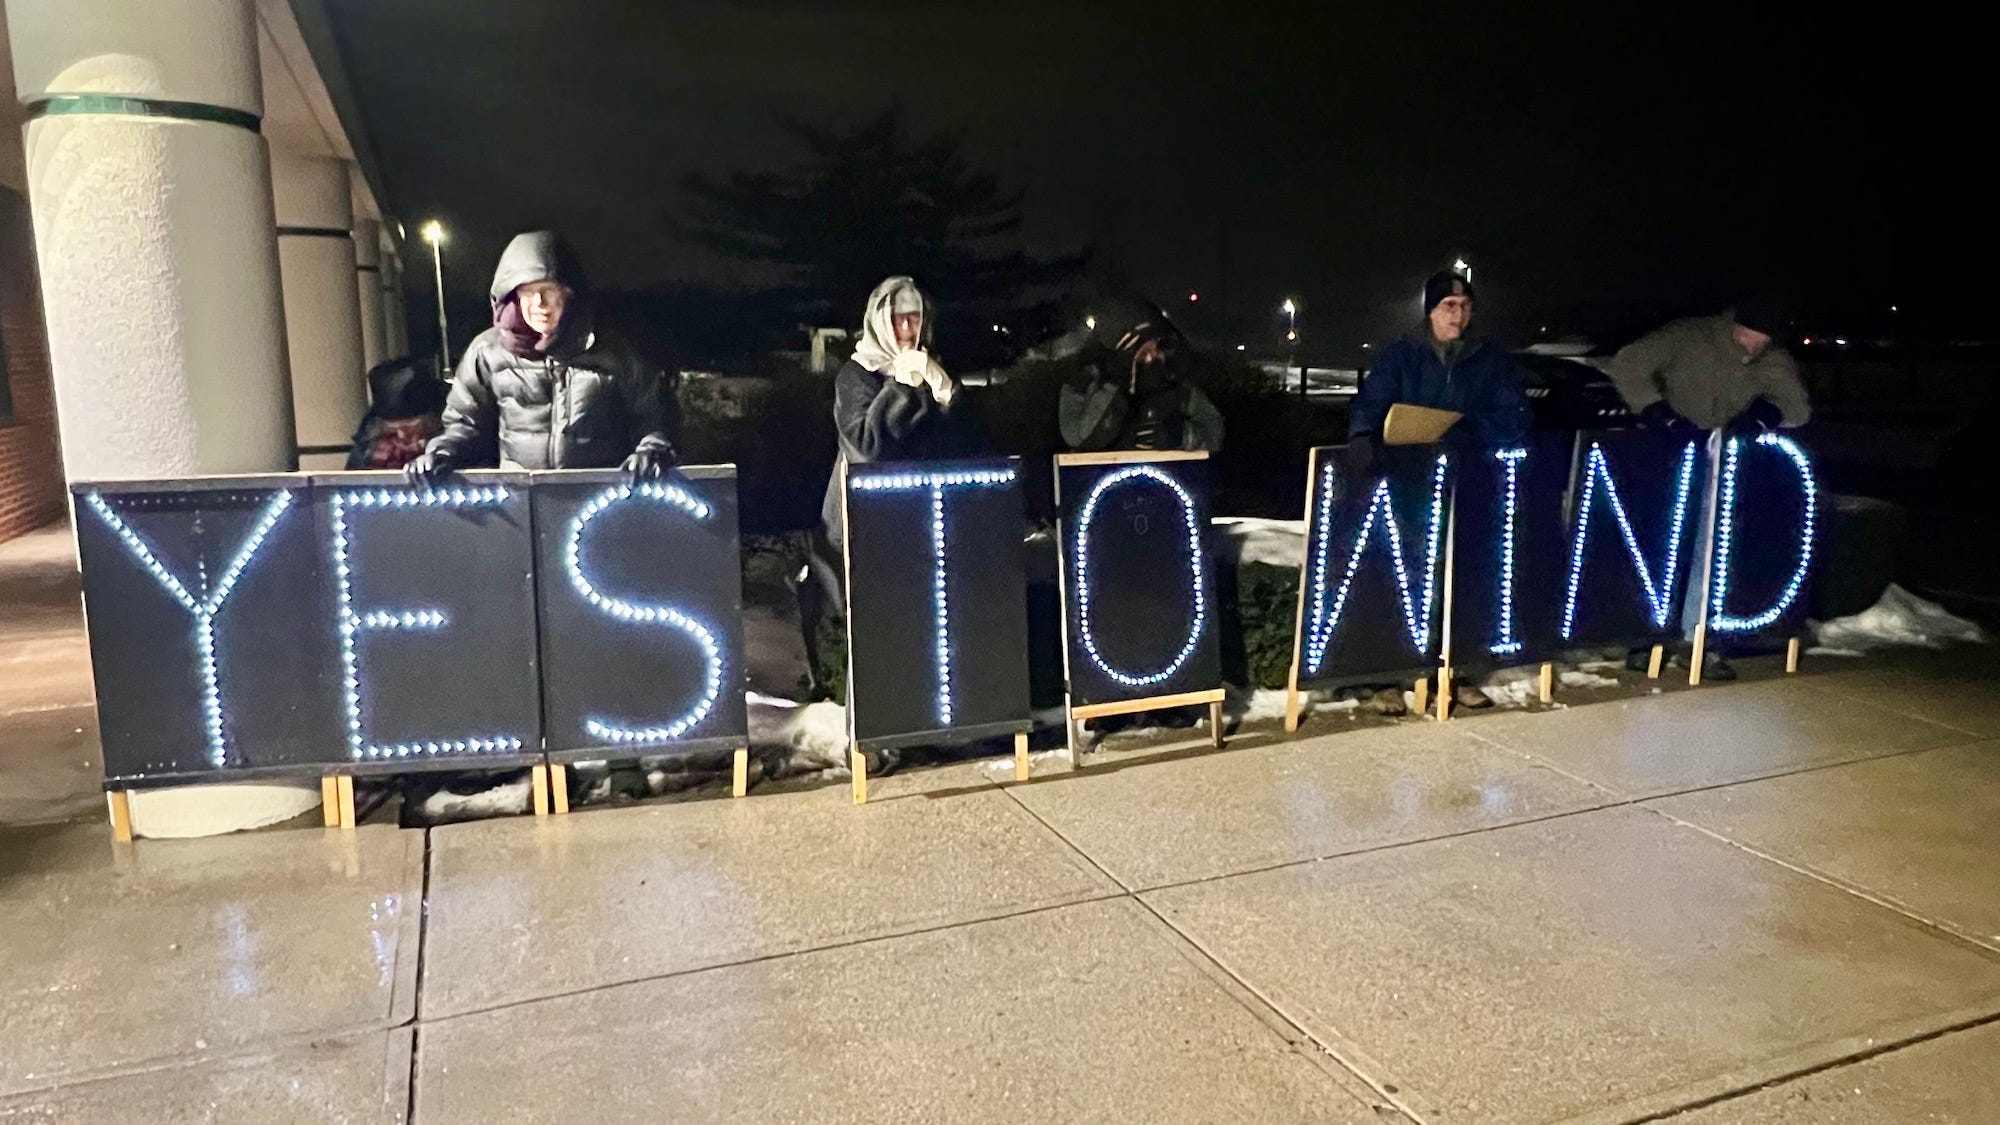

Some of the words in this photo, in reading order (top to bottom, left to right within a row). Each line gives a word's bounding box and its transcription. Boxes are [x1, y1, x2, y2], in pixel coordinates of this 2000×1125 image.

[86, 482, 720, 766] YES
[851, 465, 1204, 725] TO
[1306, 433, 1816, 673] WIND
